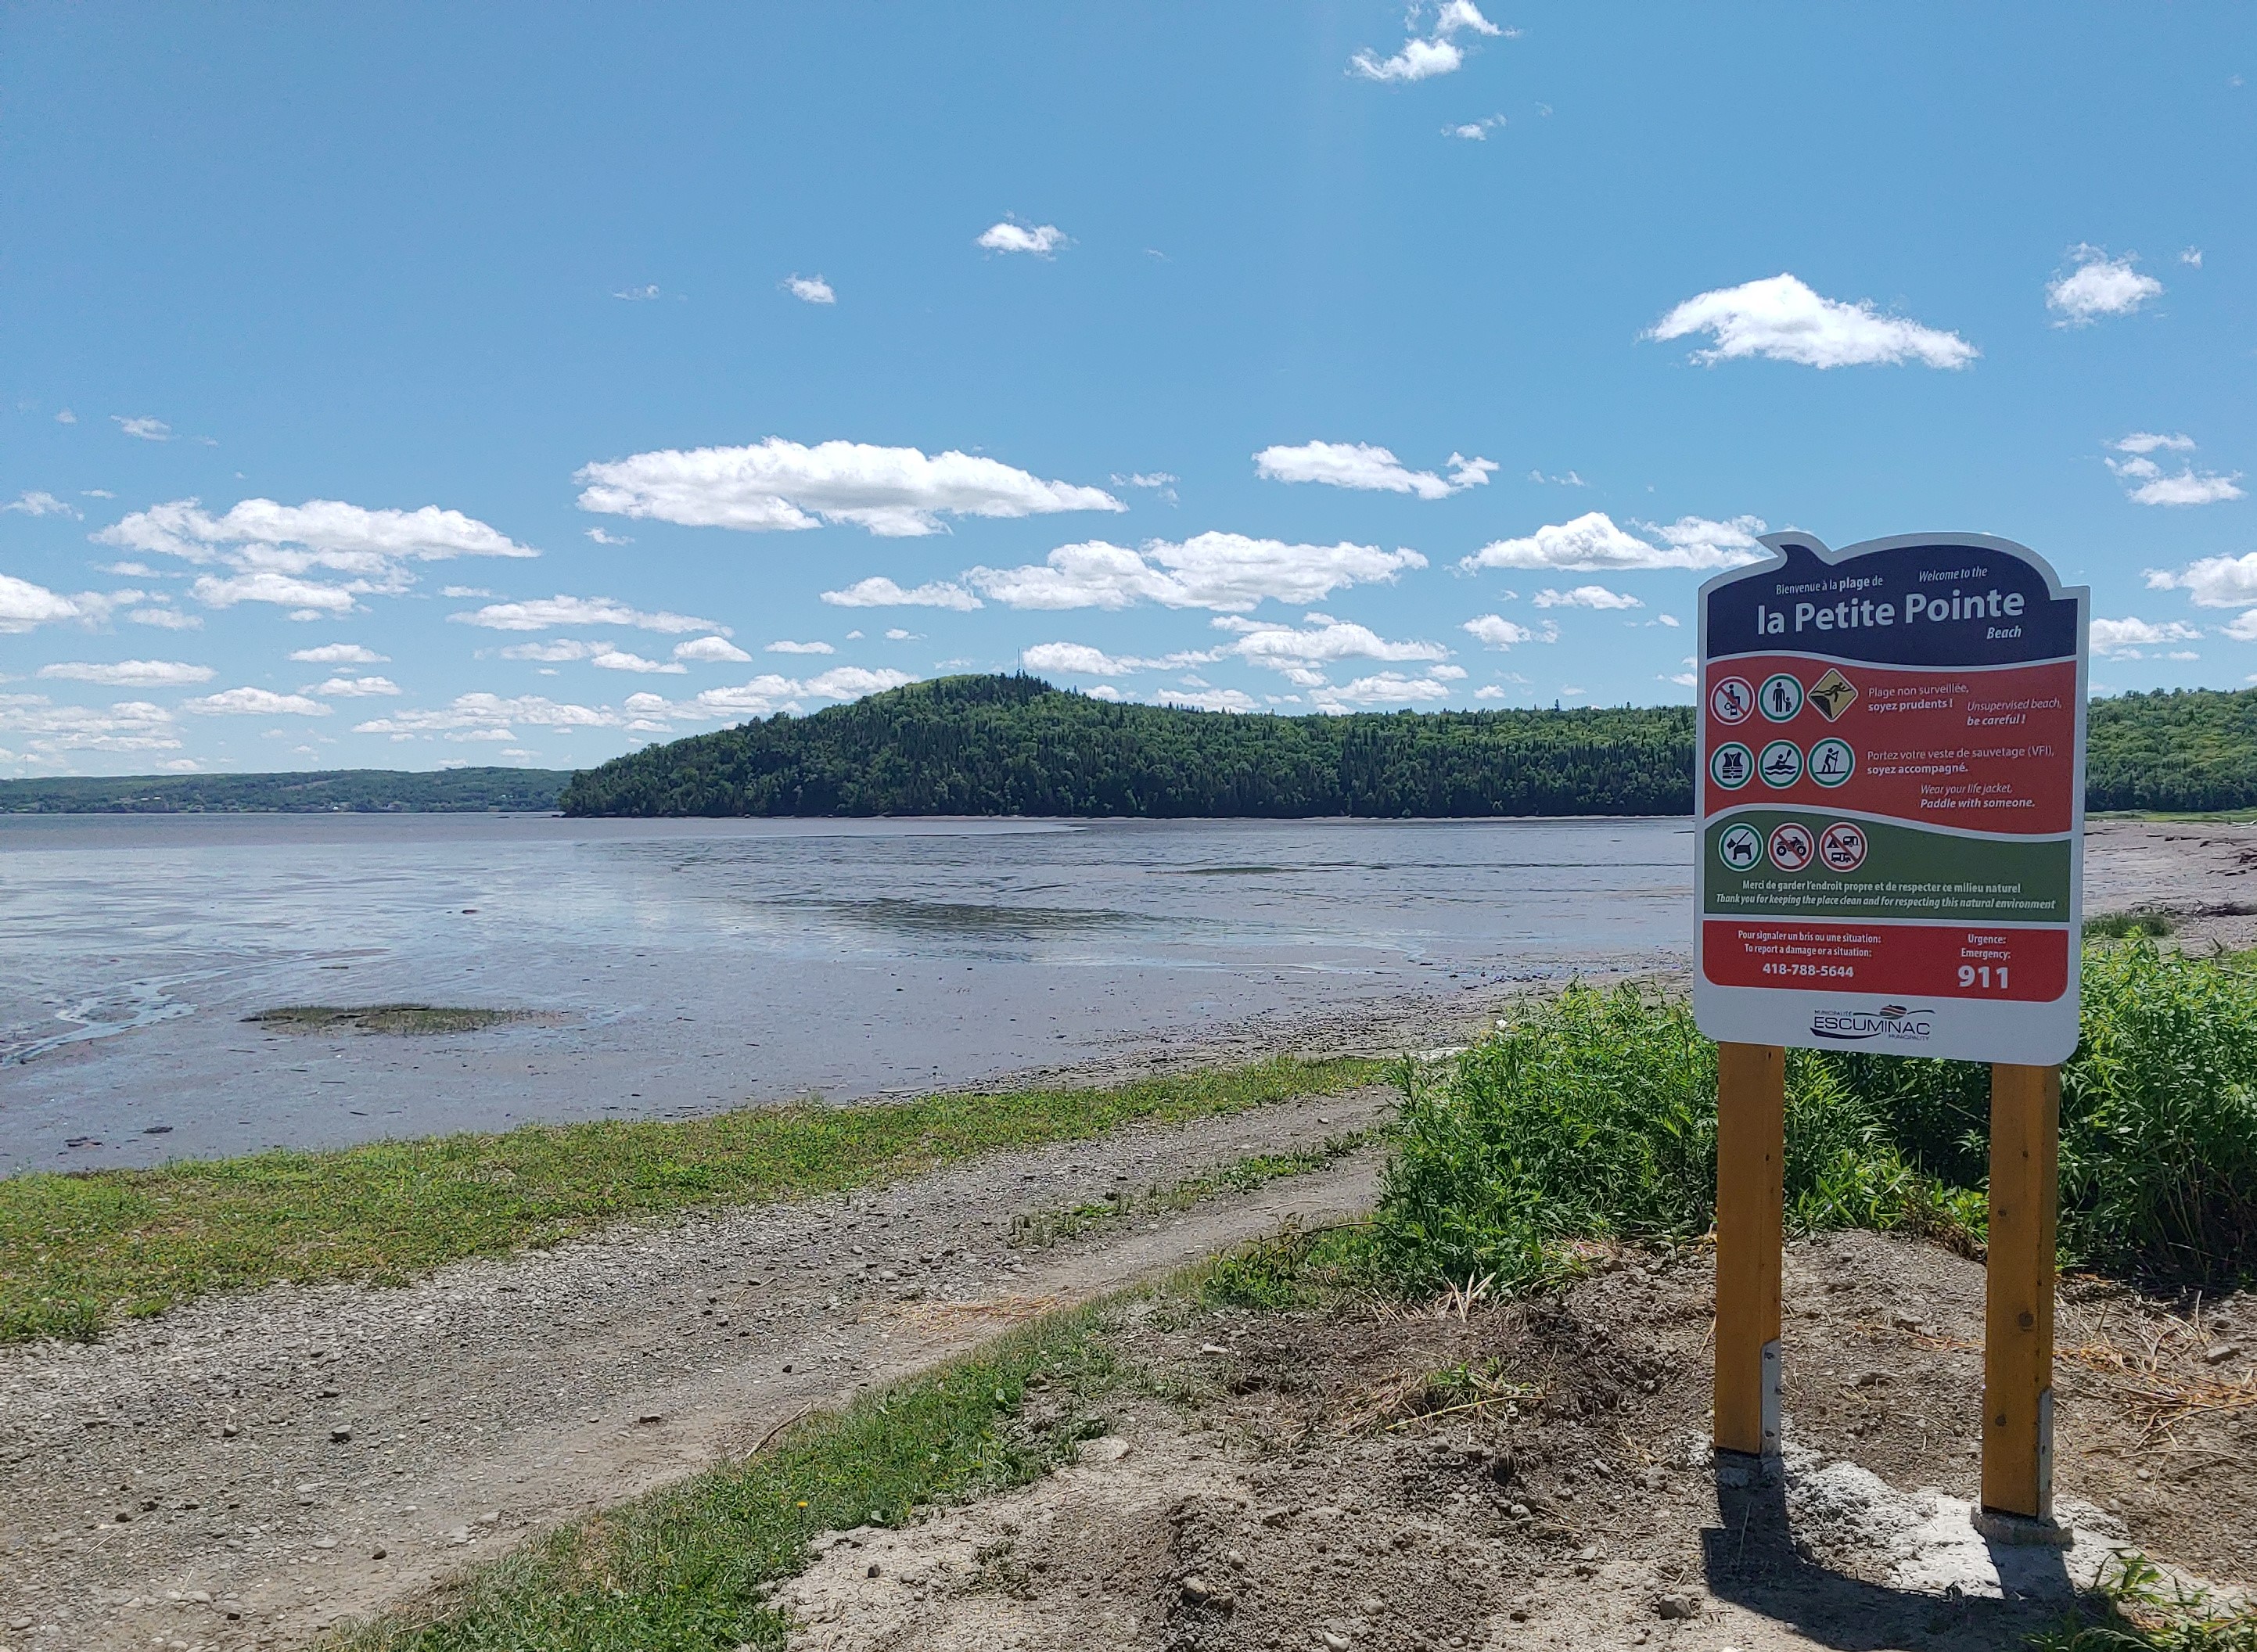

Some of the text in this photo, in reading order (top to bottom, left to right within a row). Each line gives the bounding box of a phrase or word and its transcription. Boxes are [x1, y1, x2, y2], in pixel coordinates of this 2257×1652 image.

[1919, 566, 1988, 583] Welcome to the
[1776, 582, 1820, 595] Bienvenue
[1829, 579, 1838, 590] la
[1839, 576, 1870, 592] plage
[1872, 575, 1884, 586] de
[1758, 589, 2025, 635] la Petite Pointe
[1987, 625, 2022, 639] Beach
[1868, 687, 1896, 699] Plage
[1897, 688, 1917, 696] non
[1868, 702, 1898, 713] soyez
[1899, 699, 1947, 713] prudents
[1968, 697, 2062, 713] Unsupervised beach,
[1967, 716, 1980, 726] be
[1982, 713, 2020, 726] careful
[1867, 750, 1898, 760] Portez
[1900, 750, 1926, 760] votre
[1928, 749, 1955, 759] veste
[1957, 748, 1970, 758] de
[1972, 747, 2025, 759] sauvetage
[1867, 763, 1968, 777] soyez accompagné.
[1921, 783, 2013, 796] Wear your life jacket,
[1920, 798, 2036, 809] Paddle with someone.
[1742, 879, 1764, 890] Merci
[1766, 880, 1777, 890] de
[1777, 880, 1806, 892] garder
[1844, 882, 1874, 893] propre
[1874, 882, 1885, 892] et
[1885, 882, 1897, 892] de
[1898, 882, 1942, 894] respecter
[1943, 884, 1952, 892] ce
[1953, 882, 1984, 893] milieu
[1986, 883, 2022, 893] naturel
[1716, 893, 2057, 910] Thank you for keeping the place clean and for respecting this natural environment
[1738, 930, 1756, 939] Pour
[1756, 930, 1787, 942] signaler
[1799, 932, 1813, 941] bris
[1826, 934, 1841, 943] une
[1842, 933, 1881, 943] situation:
[1968, 933, 2007, 946] Urgence:
[1745, 943, 1753, 953] To
[1754, 945, 1778, 955] report
[1785, 945, 1817, 957] damage
[1834, 946, 1872, 957] situation:
[1961, 947, 2011, 961] Emergency:
[1763, 963, 1854, 978] 418-788-5644
[1958, 964, 2008, 989] 911
[1814, 1016, 1931, 1036] ESCUMINAC
